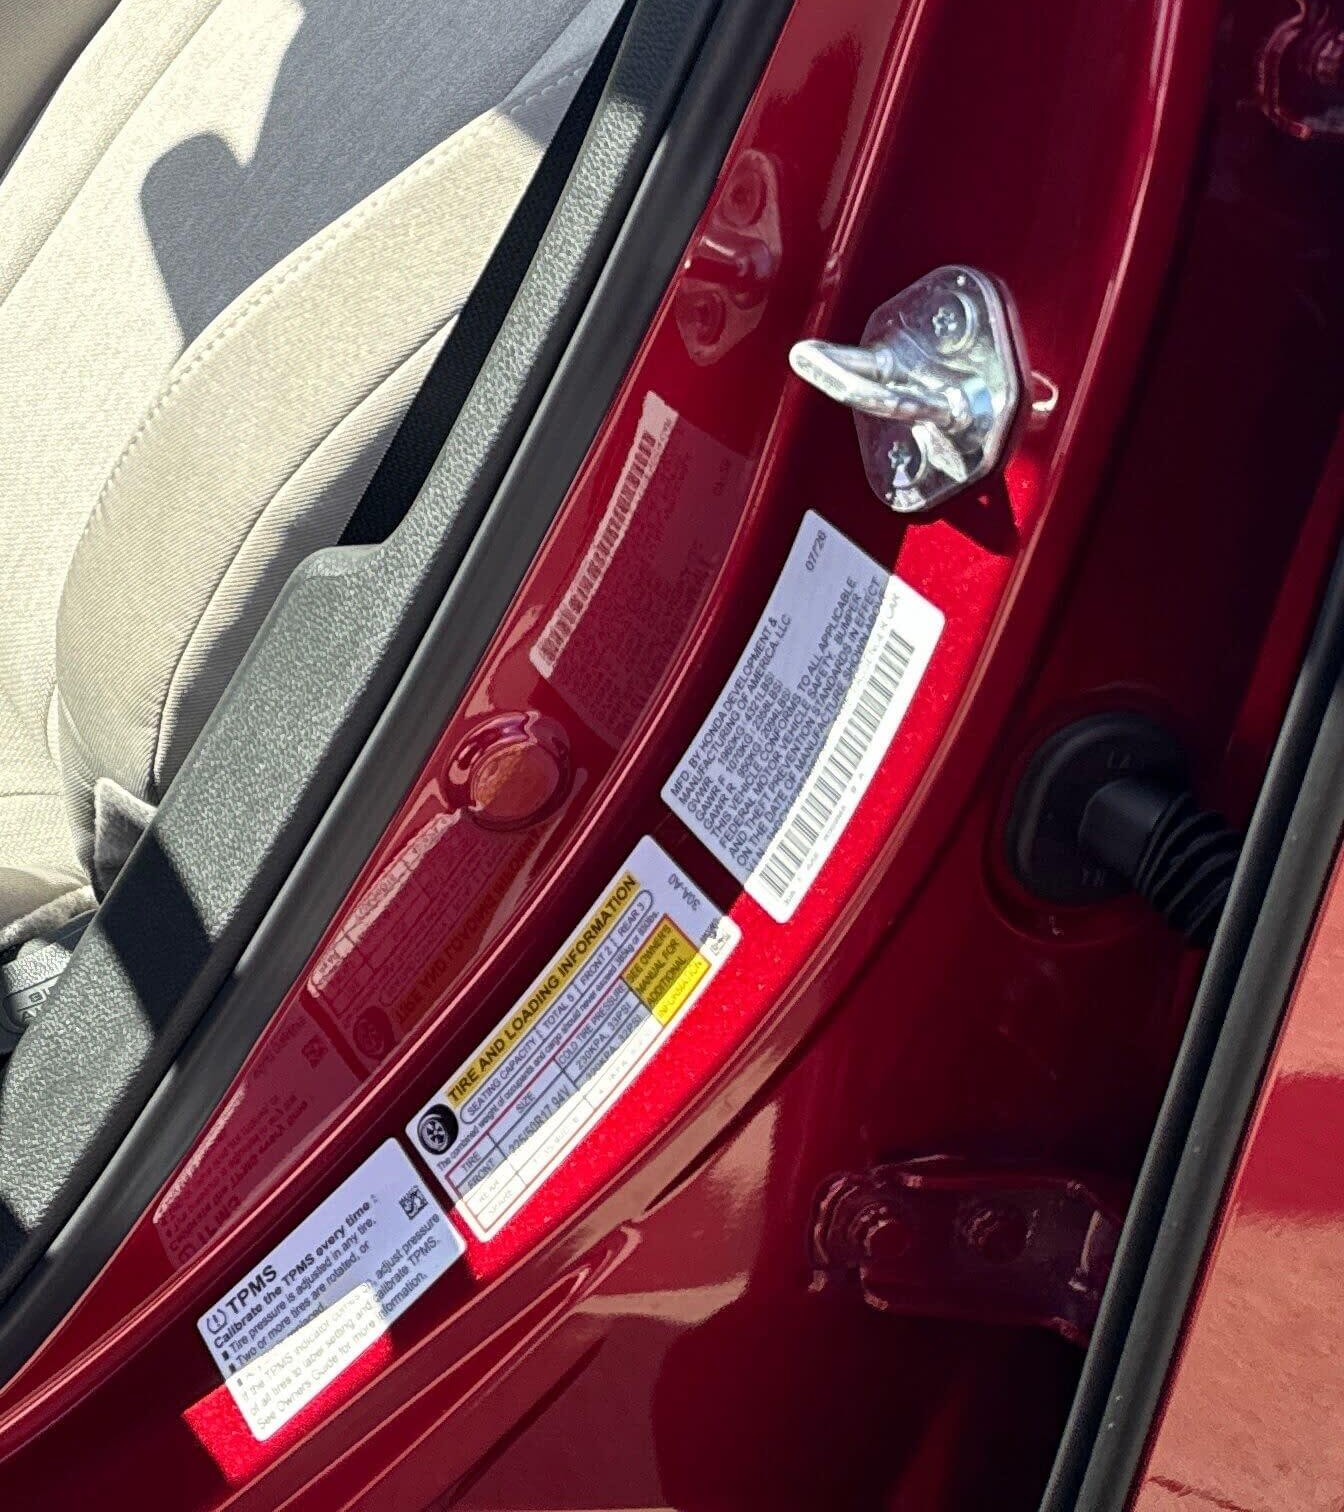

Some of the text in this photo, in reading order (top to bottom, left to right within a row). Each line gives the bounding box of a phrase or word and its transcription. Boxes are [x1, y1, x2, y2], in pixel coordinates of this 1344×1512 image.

[678, 708, 740, 806] MANUFACTURING
[773, 612, 792, 639] LLC
[698, 708, 727, 753] HONDA
[722, 623, 773, 714] DEVELOPMENT
[710, 808, 732, 840] THIS
[728, 760, 763, 812] VEHICLE
[758, 690, 801, 764] CONFORMS
[805, 649, 823, 676] ALL
[816, 574, 857, 654] APPLICABLE
[727, 828, 748, 858] AND
[744, 791, 771, 831] THEFT
[767, 712, 816, 796] PREVENTION
[809, 641, 854, 717] STANDARDS
[853, 574, 882, 628] EFFECT
[718, 794, 755, 849] FEDERAL
[752, 749, 783, 797] MOTOR
[778, 697, 811, 752] VEHICLE
[749, 820, 768, 847] THE
[763, 787, 788, 825] DATE
[793, 679, 847, 774] MANUFACTURE
[841, 630, 869, 682] SHOWN
[686, 774, 713, 814] GVWR
[694, 783, 721, 823] GAWR
[702, 792, 729, 832] GAWR
[616, 909, 640, 937] REAR
[447, 1066, 479, 1106] TIRE
[475, 1033, 508, 1074] AND
[503, 970, 561, 1041] LOADING
[555, 873, 637, 978] INFORMATION
[578, 953, 606, 986] FRONT
[634, 956, 667, 995] MANUAL
[644, 954, 688, 1007] ADDITIONAL
[542, 1001, 567, 1031] TOTAL
[556, 1038, 579, 1066] COLD
[575, 1022, 593, 1044] TIRE
[589, 980, 627, 1027] PRESSURE
[436, 1153, 451, 1173] The
[543, 1030, 564, 1056] cargo
[466, 1033, 538, 1119] SEATING CAPACITY
[514, 1089, 536, 1115] SIZE
[460, 1148, 481, 1175] TIRE
[213, 1298, 263, 1351] Calibrate
[262, 1282, 282, 1306] the
[282, 1252, 315, 1287] TPMS
[314, 1224, 347, 1259] every
[344, 1198, 371, 1227] time
[370, 1261, 410, 1303] calibrate
[373, 1211, 442, 1281] adjust pressure
[225, 1261, 278, 1319] TPMS
[229, 1331, 249, 1355] Tire
[247, 1298, 287, 1340] pressure
[293, 1254, 334, 1297] adjusted
[340, 1231, 359, 1252] any
[235, 1342, 257, 1368] Two
[266, 1313, 291, 1341] more
[289, 1294, 311, 1319] tires
[309, 1280, 326, 1301] are
